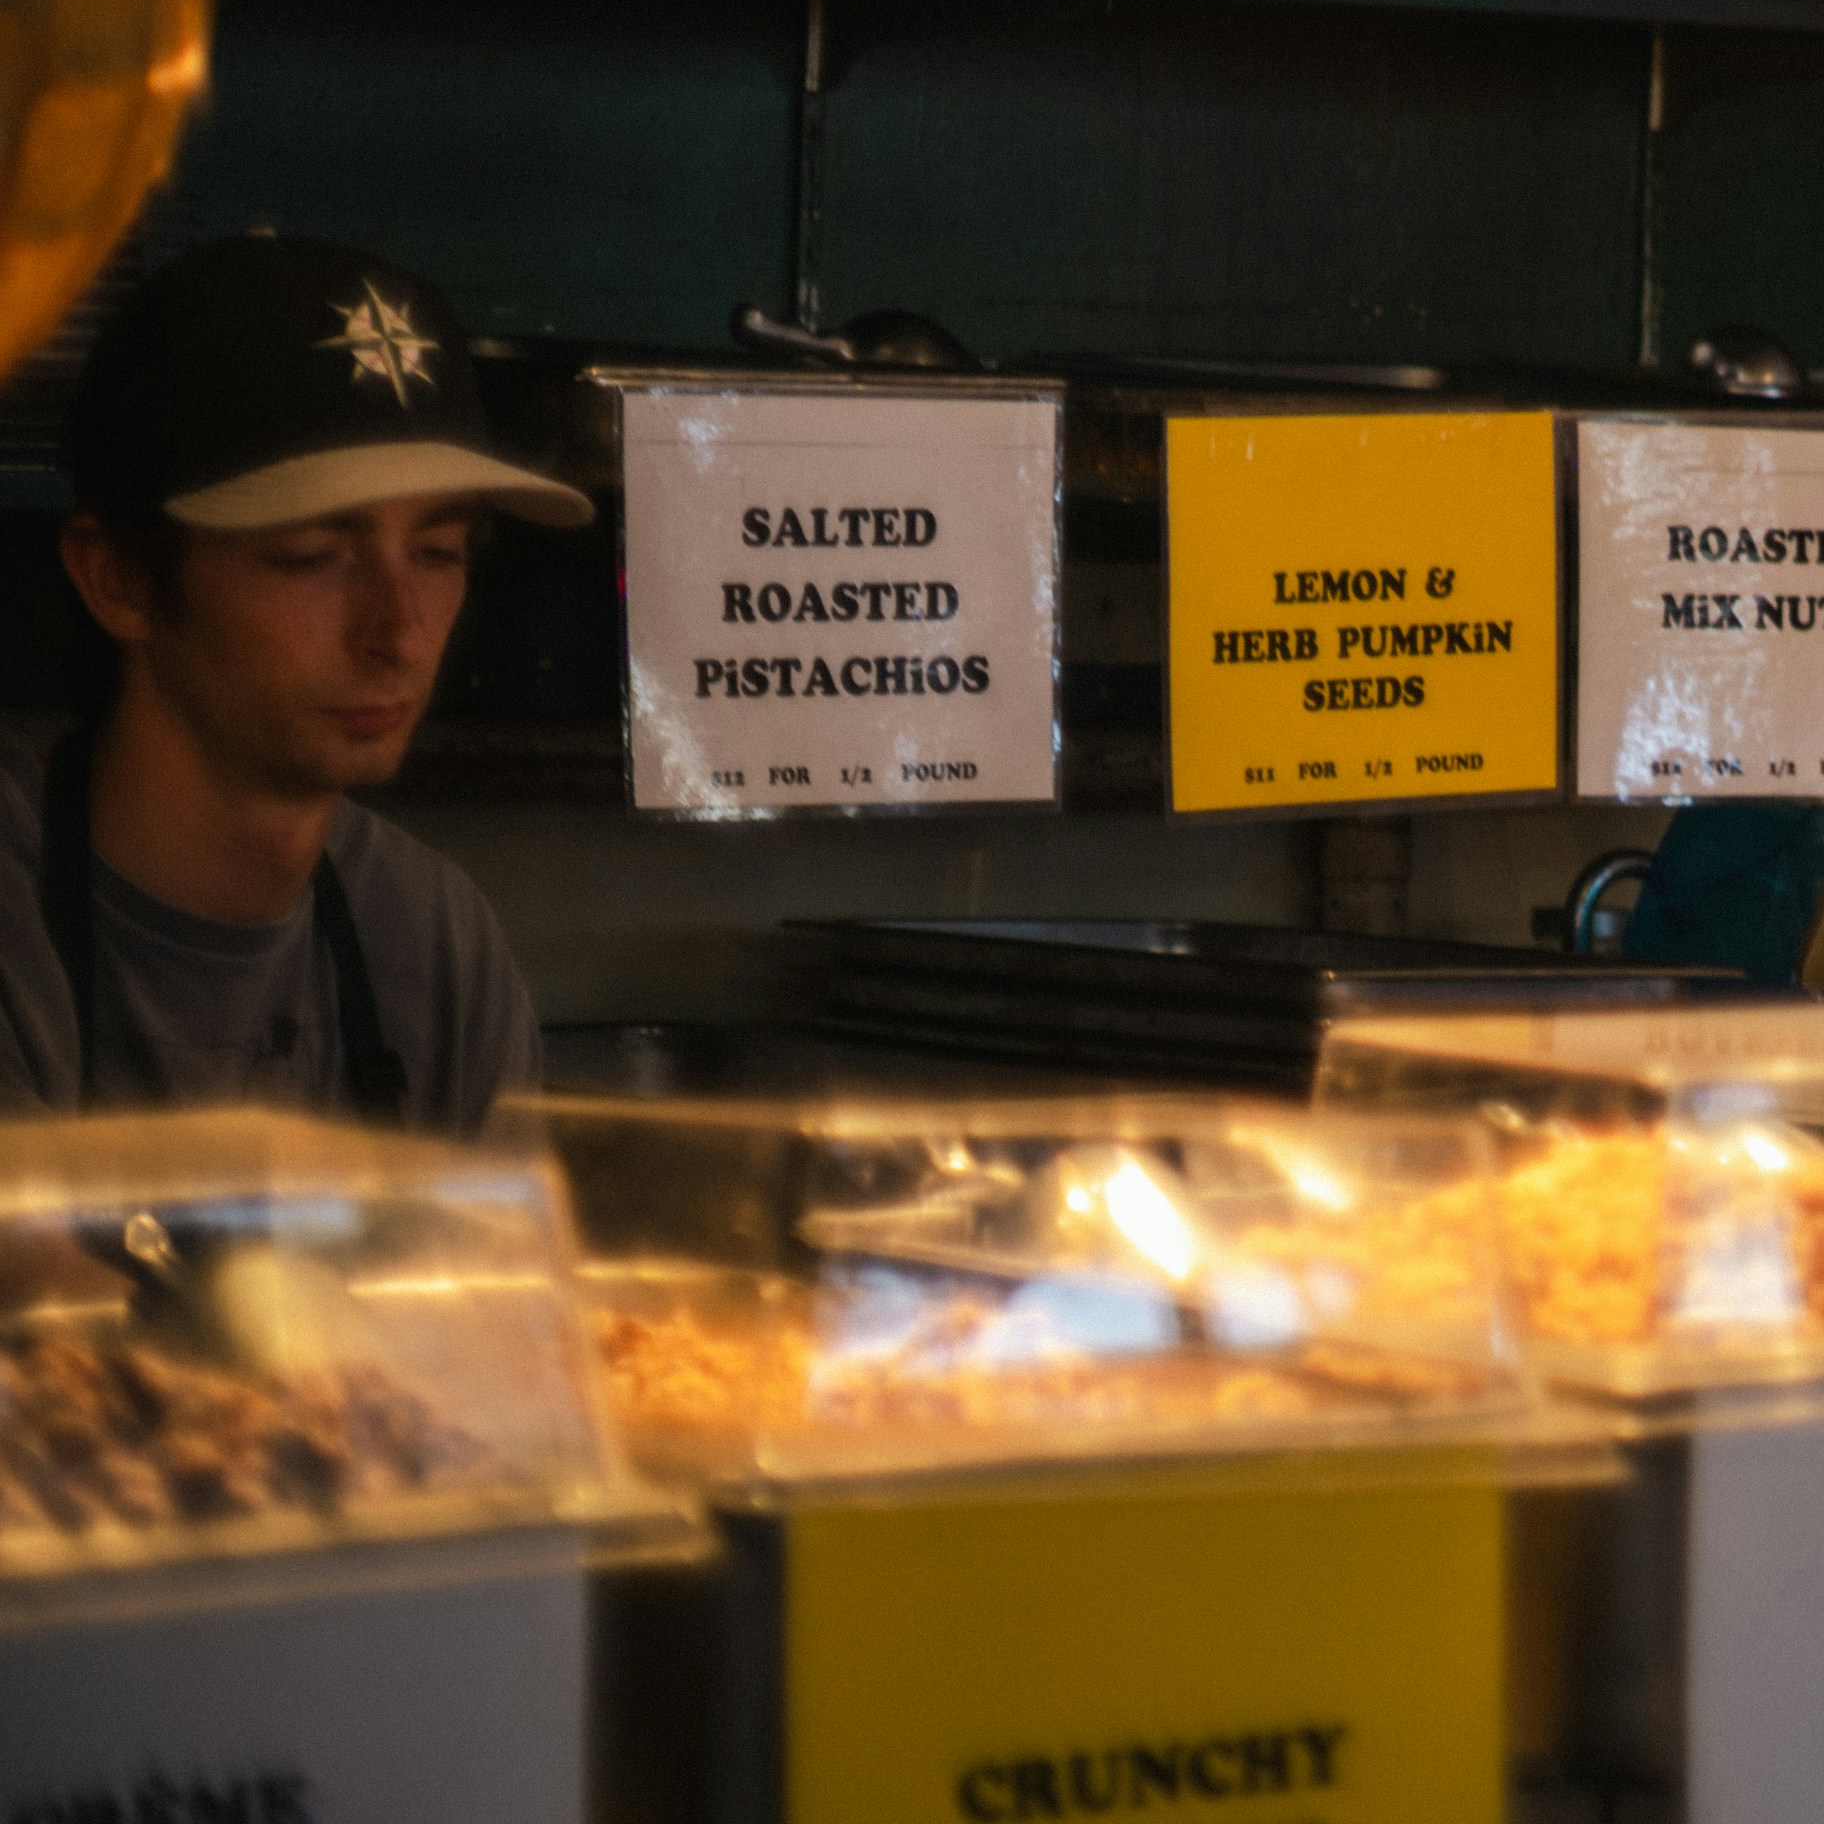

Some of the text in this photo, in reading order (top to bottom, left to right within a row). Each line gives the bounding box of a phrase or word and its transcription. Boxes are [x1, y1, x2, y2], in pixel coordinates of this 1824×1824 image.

[742, 506, 937, 548] SALTED
[722, 581, 959, 623] ROASTED
[1273, 566, 1456, 605] LEMON &
[1212, 628, 1319, 664] HERB
[1303, 676, 1426, 712] SEEDS
[769, 766, 811, 785] FOR
[840, 764, 873, 787] 1/2
[903, 761, 977, 781] POUND
[1299, 762, 1337, 781] FOR
[1365, 760, 1393, 779] 1/2
[1416, 753, 1483, 774] POUND
[1769, 758, 1796, 778] 1/2
[955, 1726, 1349, 1823] CRUNCHY
